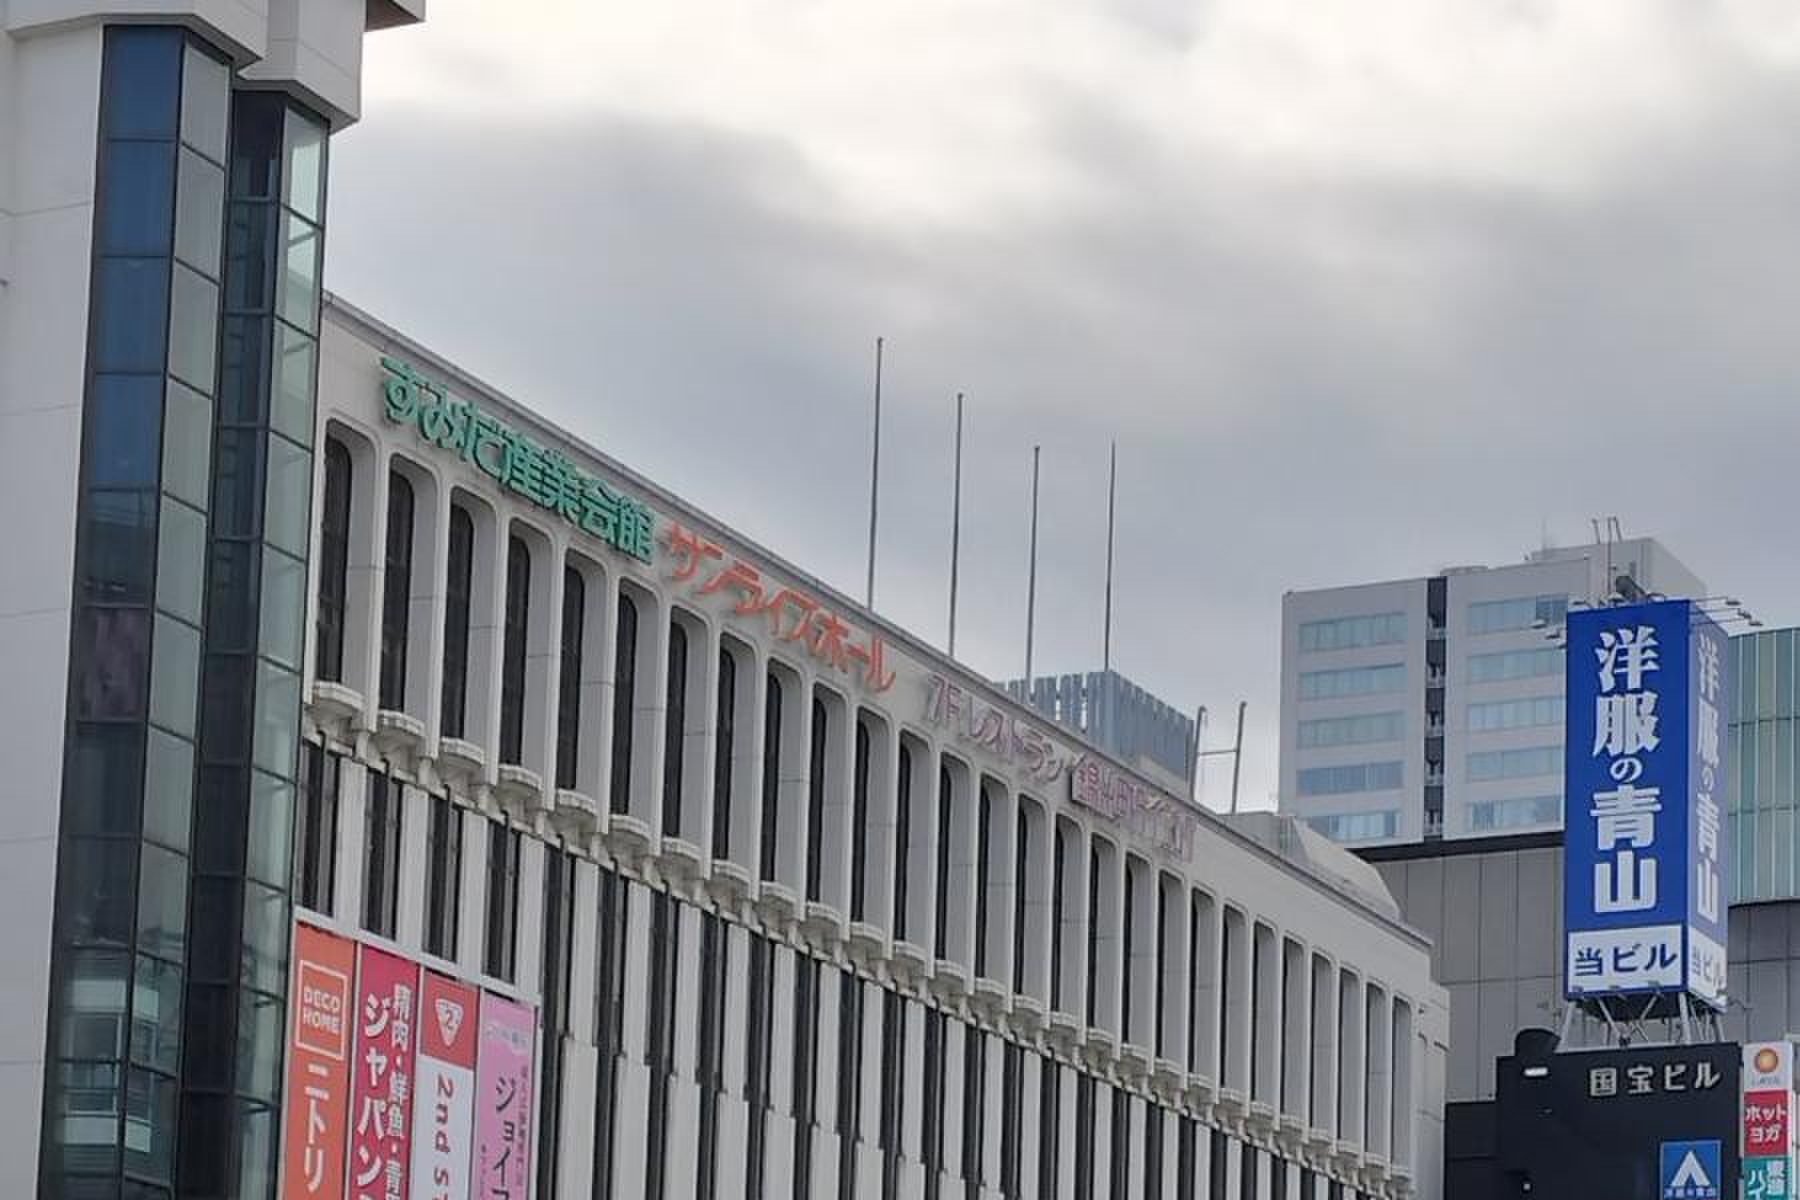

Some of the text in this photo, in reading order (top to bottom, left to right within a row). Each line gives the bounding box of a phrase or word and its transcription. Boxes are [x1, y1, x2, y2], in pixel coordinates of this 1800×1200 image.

[381, 356, 657, 565] すみだ産業会館
[666, 521, 897, 692] サンライズホール
[1589, 624, 1662, 913] 洋服の青山
[1695, 633, 1721, 925] 洋服の青山
[1574, 943, 1678, 976] 当ビル
[302, 1007, 341, 1035] HOME
[303, 985, 341, 1014] DECO
[1589, 1061, 1721, 1097] 国宝ビル
[303, 1063, 330, 1194] ニトリ
[434, 1073, 454, 1155] 2nd
[1745, 1104, 1788, 1121] ホット
[1750, 1127, 1782, 1144] ヨガ
